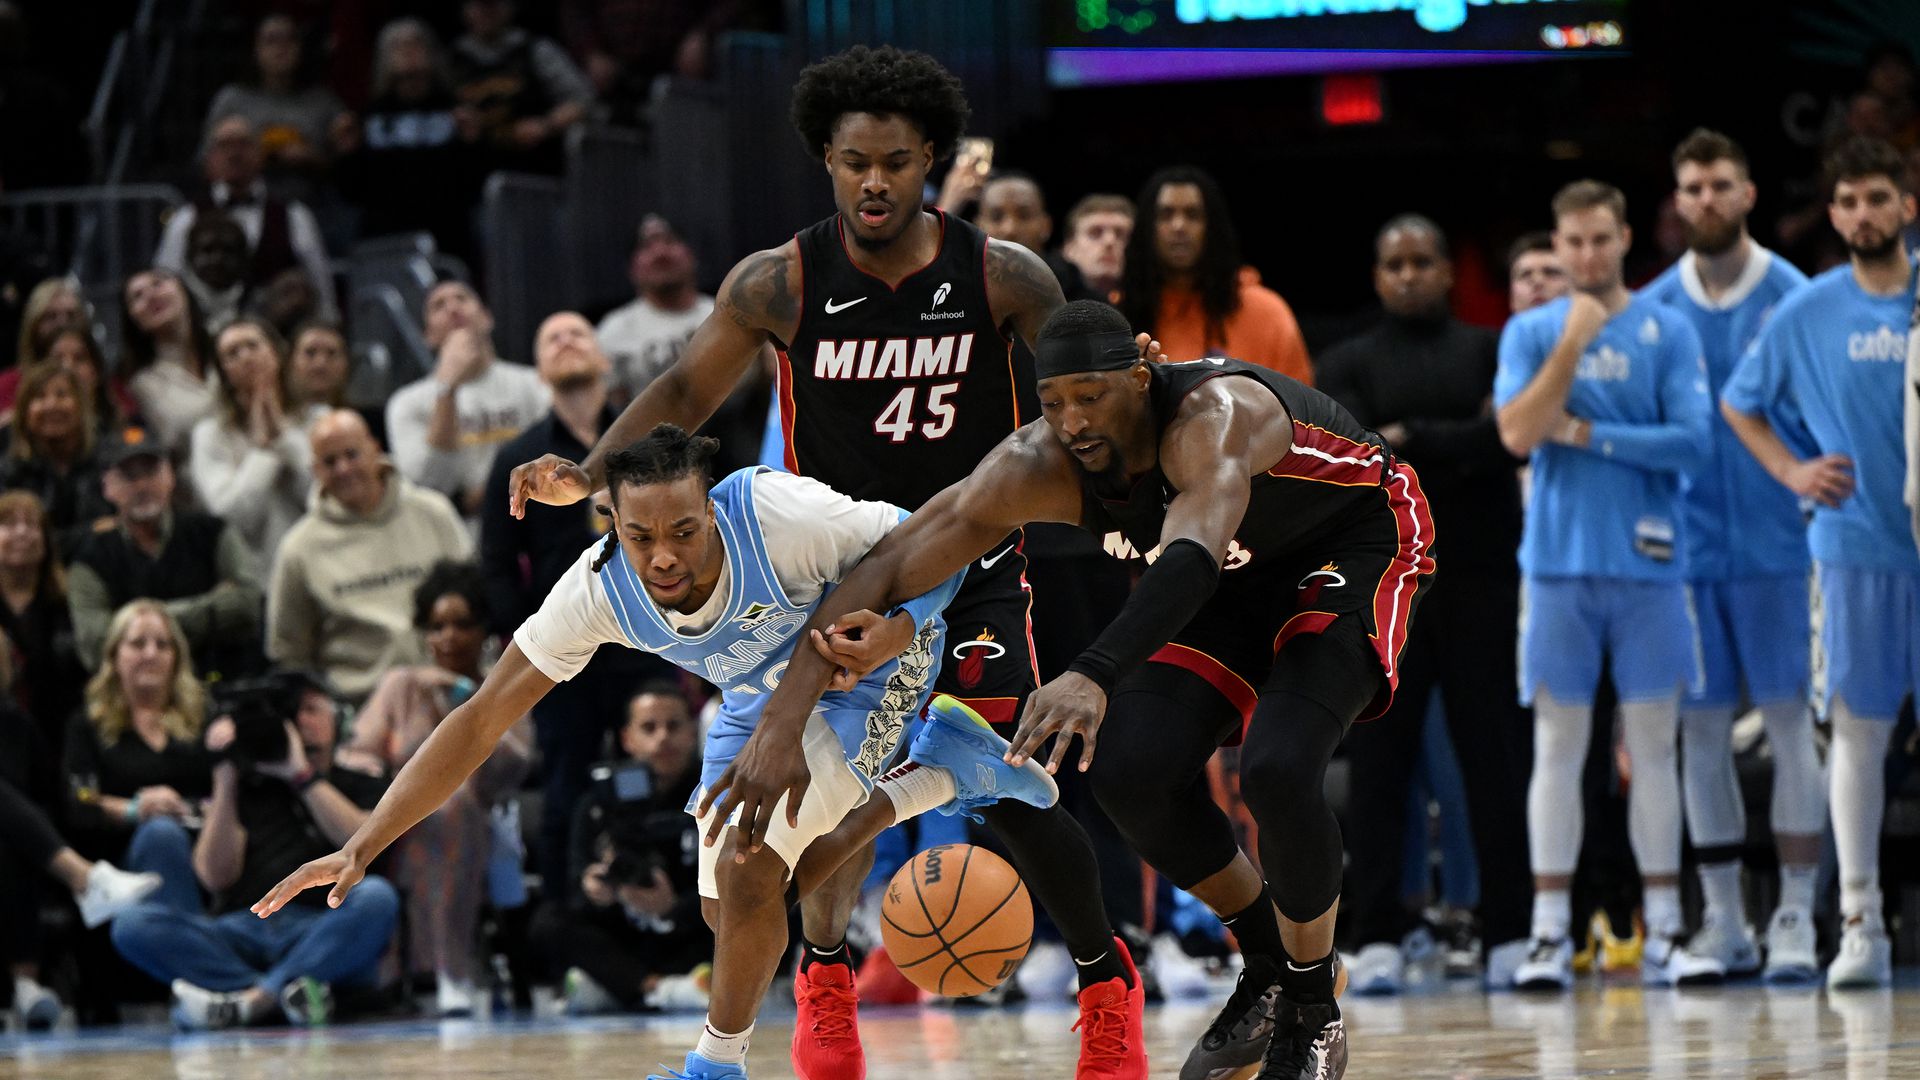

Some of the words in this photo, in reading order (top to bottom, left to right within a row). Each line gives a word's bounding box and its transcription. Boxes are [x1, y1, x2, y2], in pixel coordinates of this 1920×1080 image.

[920, 310, 964, 321] Robinhood
[814, 332, 975, 379] MIAMI
[873, 382, 959, 443] 45
